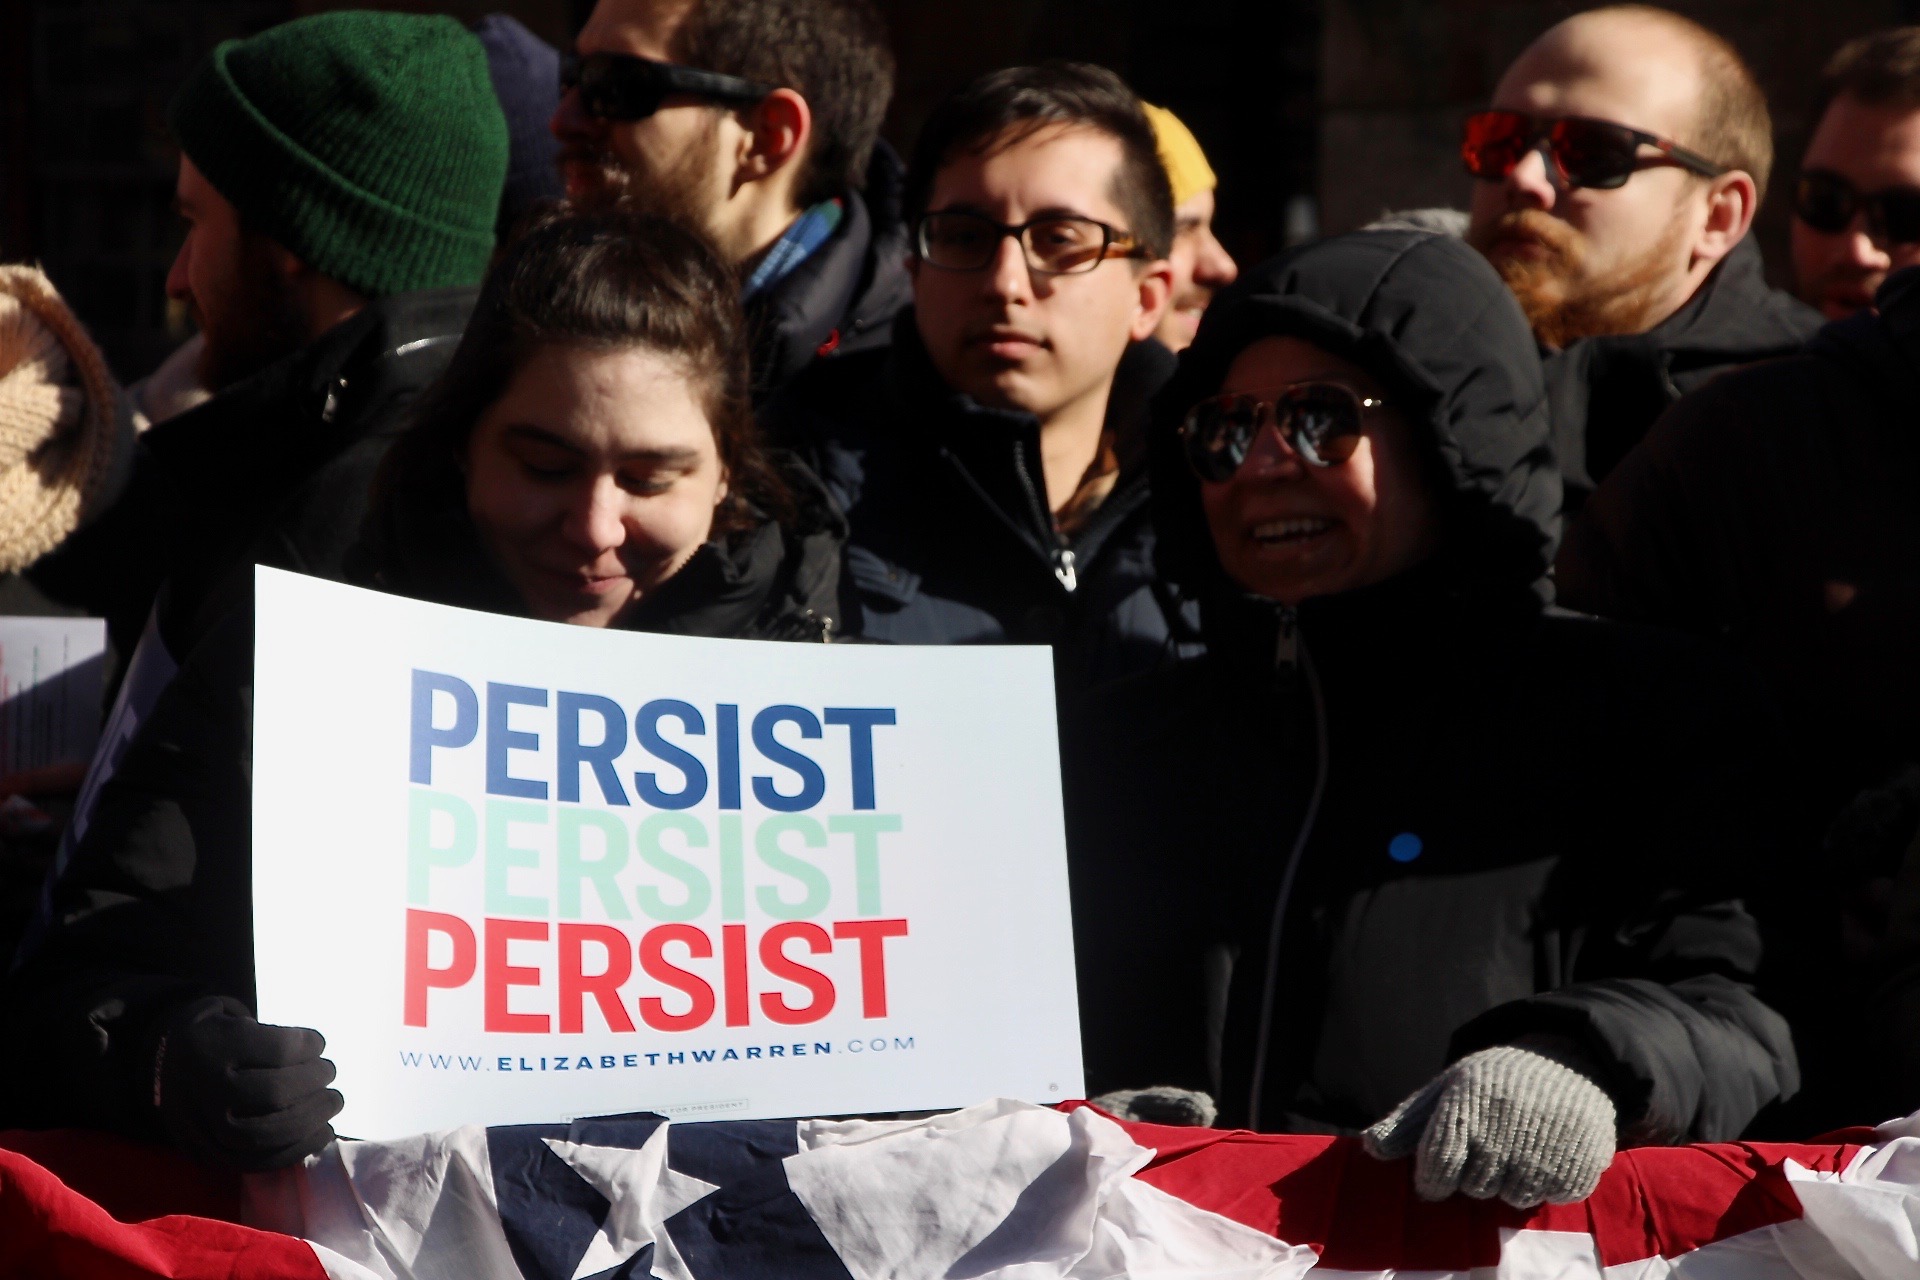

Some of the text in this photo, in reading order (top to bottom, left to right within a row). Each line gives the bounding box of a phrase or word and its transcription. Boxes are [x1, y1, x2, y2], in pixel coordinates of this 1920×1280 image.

[408, 668, 896, 812] PERSIST
[405, 787, 903, 921] PERSIST
[403, 908, 908, 1034] PERSIST
[399, 1037, 915, 1072] WWW.ELIZABETHWARREN.COM
[691, 1102, 744, 1112] PRESIDENT
